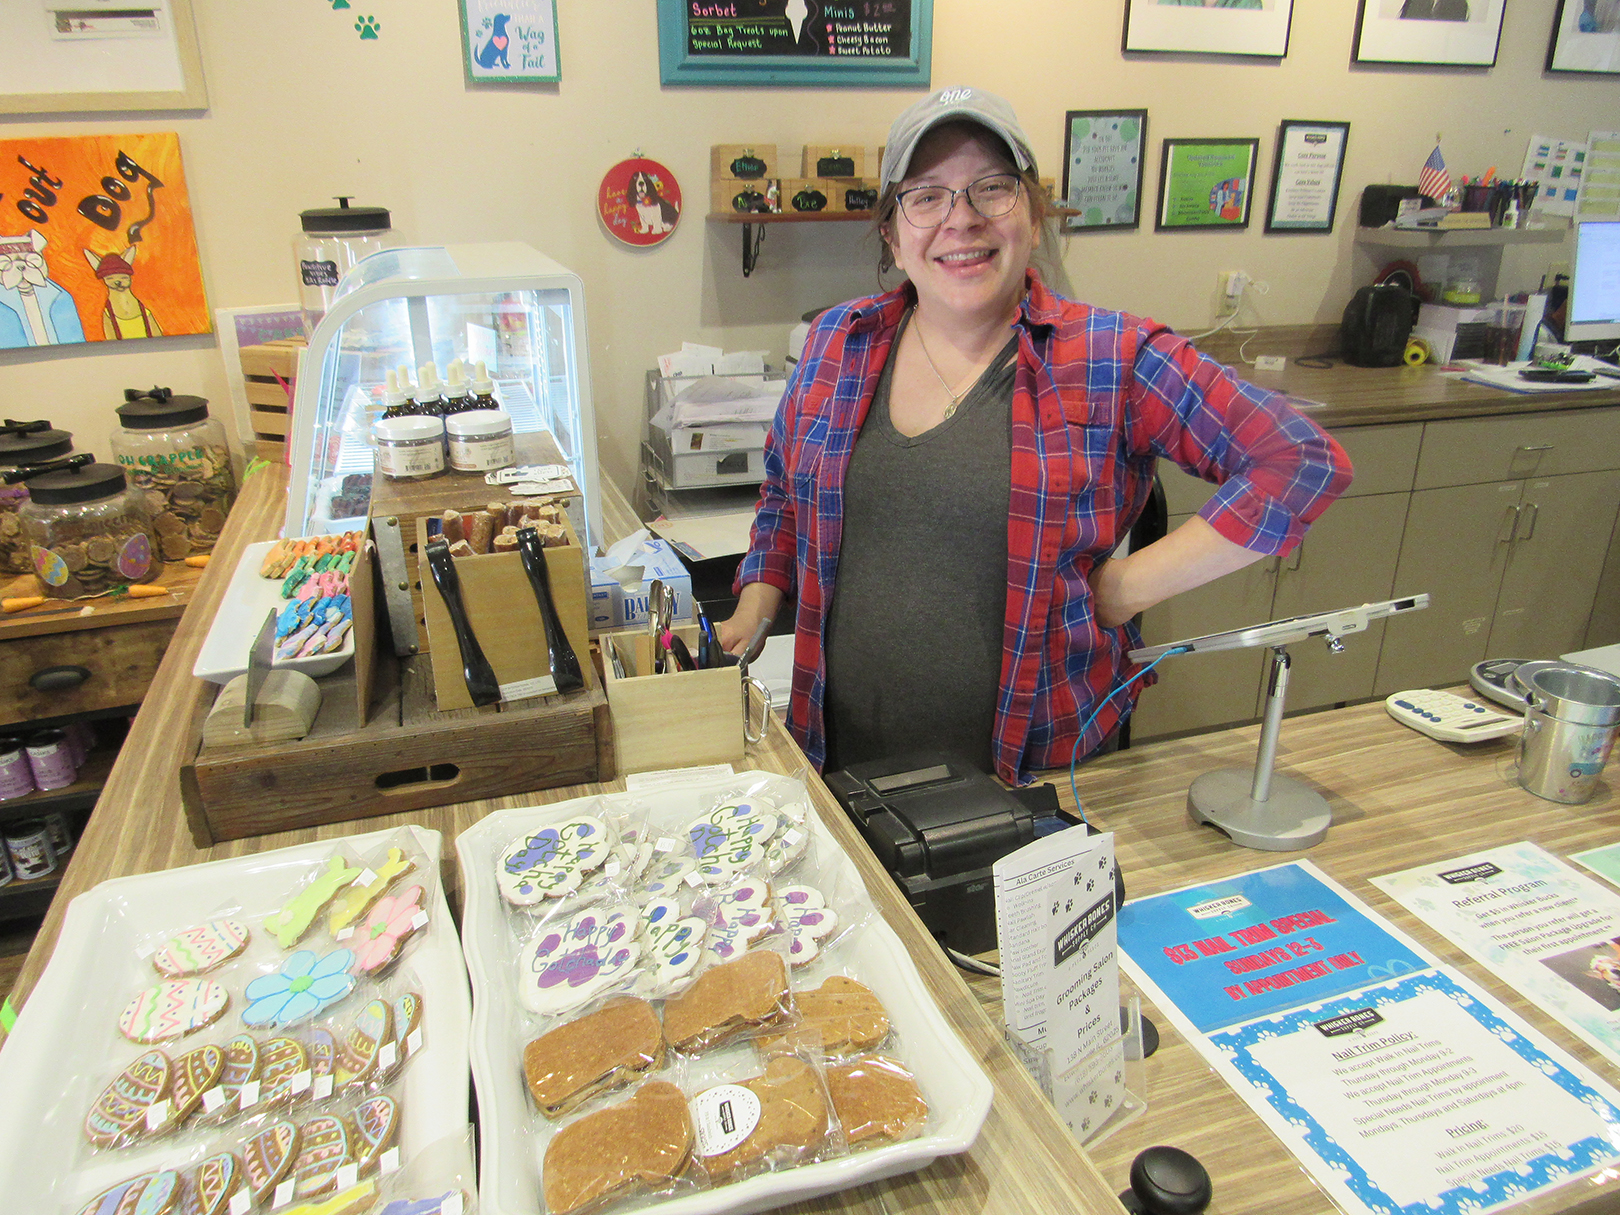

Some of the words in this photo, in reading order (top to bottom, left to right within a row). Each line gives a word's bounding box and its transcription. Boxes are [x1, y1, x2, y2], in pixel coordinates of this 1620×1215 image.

[692, 3, 737, 18] Sorbet
[515, 26, 545, 45] Wag
[717, 27, 734, 39] Bag
[736, 26, 765, 36] Treats
[769, 27, 789, 38] upon
[863, 23, 892, 34] Butter
[864, 35, 889, 45] Bacon
[728, 38, 763, 51] Request
[862, 46, 891, 55] Potato
[520, 54, 546, 70] Tail
[78, 150, 165, 232] Dog
[138, 449, 206, 468] CRAPPLE
[1015, 877, 1028, 887] Ala
[1028, 869, 1047, 882] Carte
[1047, 859, 1075, 875] Services
[1192, 901, 1221, 914] WHISKER
[1452, 889, 1502, 909] Referral
[1497, 879, 1549, 897] Program
[1475, 911, 1491, 920] Get
[1500, 904, 1509, 913] in
[1507, 898, 1538, 911] Whisker
[1535, 892, 1560, 903] Bucks
[1057, 917, 1088, 952] WHISKER
[1087, 899, 1110, 925] BONES
[1479, 919, 1502, 930] when
[1501, 915, 1516, 925] you
[1514, 910, 1534, 920] refer
[1538, 904, 1555, 912] new
[1491, 932, 1508, 942] The
[1507, 925, 1535, 938] person
[1534, 922, 1549, 932] you
[1548, 916, 1567, 928] refer
[1566, 912, 1581, 921] will
[1579, 909, 1593, 919] get
[1498, 940, 1521, 951] FREE
[1517, 935, 1542, 946] Salon
[1539, 926, 1572, 939] Package
[1568, 917, 1603, 931] Upgrade
[1599, 914, 1614, 922] for
[563, 922, 618, 949] Happy
[1163, 943, 1200, 967] $13
[1193, 936, 1239, 960] NAIL
[1228, 926, 1279, 950] TRIM
[1268, 909, 1338, 936] SPECIAL
[1522, 946, 1542, 956] their
[1540, 940, 1560, 950] first
[1222, 942, 1293, 976] SUNDAYS
[1284, 936, 1325, 957] 12-3
[1055, 967, 1093, 1006] Grooming
[1092, 951, 1114, 974] Salon
[1222, 985, 1249, 1002] BY
[1242, 960, 1335, 998] APPOINTMENT
[1327, 950, 1367, 972] ONLY
[1068, 977, 1103, 1011] Packages
[1077, 1014, 1101, 1039] Prices
[1319, 1016, 1352, 1032] WHISKER
[1350, 1009, 1376, 1023] BONES
[1331, 1047, 1356, 1063] Nail
[1353, 1039, 1381, 1055] Trim
[1379, 1030, 1419, 1047] Policy:
[1331, 1067, 1349, 1077] We
[1349, 1059, 1377, 1072] accept
[1374, 1053, 1397, 1065] Walk
[1394, 1050, 1403, 1058] In
[1401, 1043, 1421, 1056] Nail
[1418, 1039, 1442, 1052] Trims
[1341, 1069, 1380, 1087] Thursday
[1378, 1060, 1410, 1077] through
[1406, 1051, 1440, 1067] Monday
[1438, 1047, 1454, 1058] 9-2
[1342, 1091, 1360, 1101] We
[1359, 1082, 1388, 1097] accept
[1385, 1076, 1406, 1088] Nail
[1402, 1070, 1423, 1082] Trim
[1420, 1055, 1474, 1079] Appointments
[1352, 1110, 1386, 1127] Special
[1383, 1102, 1414, 1116] Needs
[1410, 1096, 1431, 1109] Nail
[1428, 1089, 1454, 1103] Trims
[1451, 1084, 1463, 1098] by
[1461, 1070, 1511, 1093] appointment
[1362, 1090, 1403, 1109] Thursday
[1400, 1081, 1433, 1098] through
[1429, 1072, 1464, 1089] Monday
[1462, 1067, 1478, 1078] 9-3
[1358, 1120, 1402, 1139] Mondays,
[1398, 1106, 1444, 1127] Thursdays
[1442, 1102, 1458, 1113] and
[1456, 1087, 1499, 1110] Saturdays
[1496, 1086, 1506, 1096] at
[1434, 1146, 1458, 1159] Walk
[1457, 1143, 1467, 1152] In
[1465, 1138, 1484, 1149] Nail
[1481, 1130, 1510, 1143] Trims:
[1506, 1123, 1525, 1135] $20
[1445, 1119, 1490, 1139] Pricing:
[1435, 1163, 1455, 1175] Nail
[1453, 1156, 1476, 1169] Trim
[1473, 1137, 1533, 1161] Appointments:
[1446, 1170, 1480, 1188] Special
[1476, 1161, 1506, 1177] Needs
[1503, 1154, 1523, 1166] Nail
